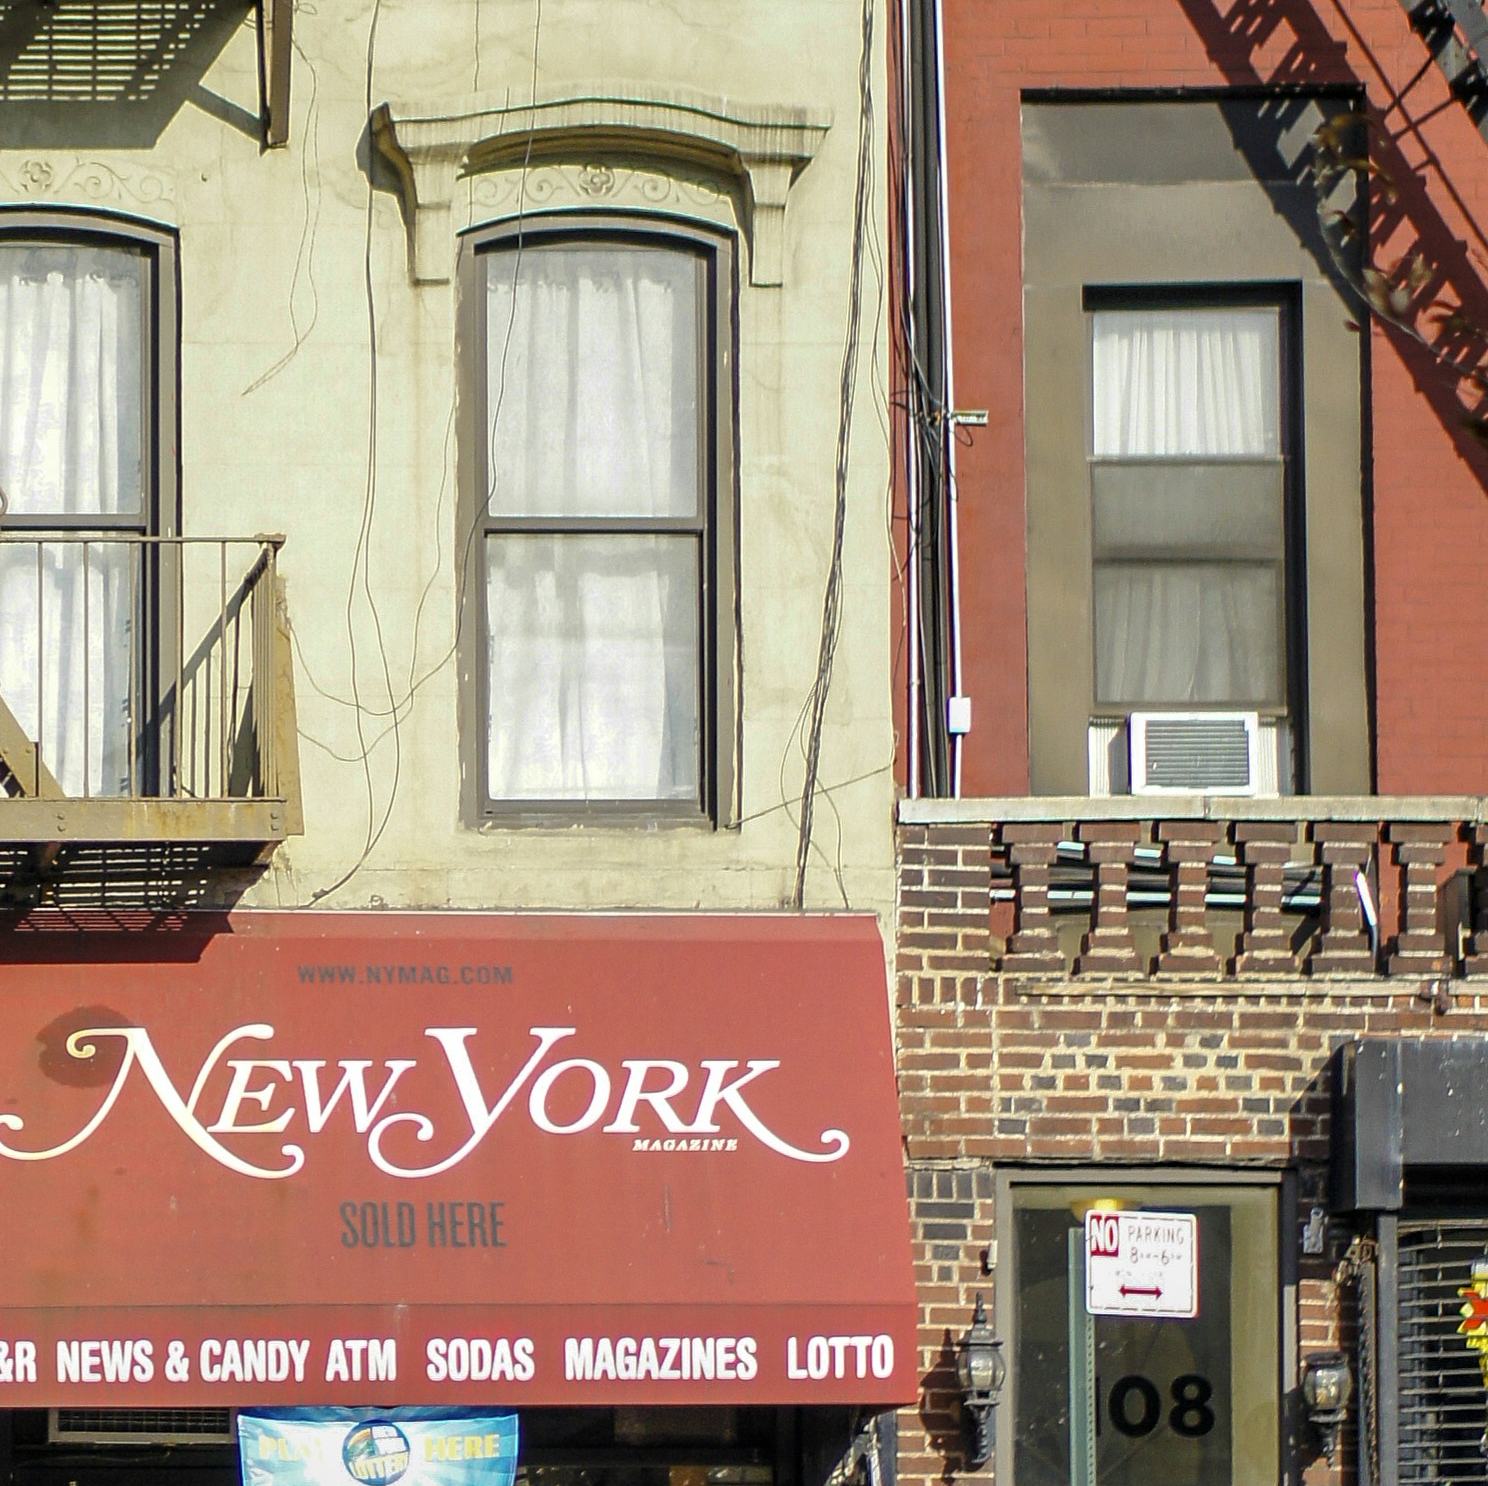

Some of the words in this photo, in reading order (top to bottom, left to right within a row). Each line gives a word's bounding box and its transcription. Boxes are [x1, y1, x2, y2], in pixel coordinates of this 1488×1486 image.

[297, 964, 514, 987] WWW.NYMAG.COM
[632, 1138, 739, 1153] MAGAZINE
[339, 1201, 417, 1249] SOLD
[428, 1201, 507, 1249] HERE
[1091, 1218, 1119, 1253] NO
[1127, 1225, 1185, 1246] PARKING
[56, 1338, 154, 1384] NEWS
[165, 1338, 189, 1384] &
[199, 1338, 308, 1384] CANDY
[325, 1338, 397, 1383] ATM
[426, 1336, 535, 1382] SODAS
[564, 1335, 758, 1381] MAGAZINES
[786, 1335, 894, 1381] LOTTO
[424, 1434, 500, 1461] HERE
